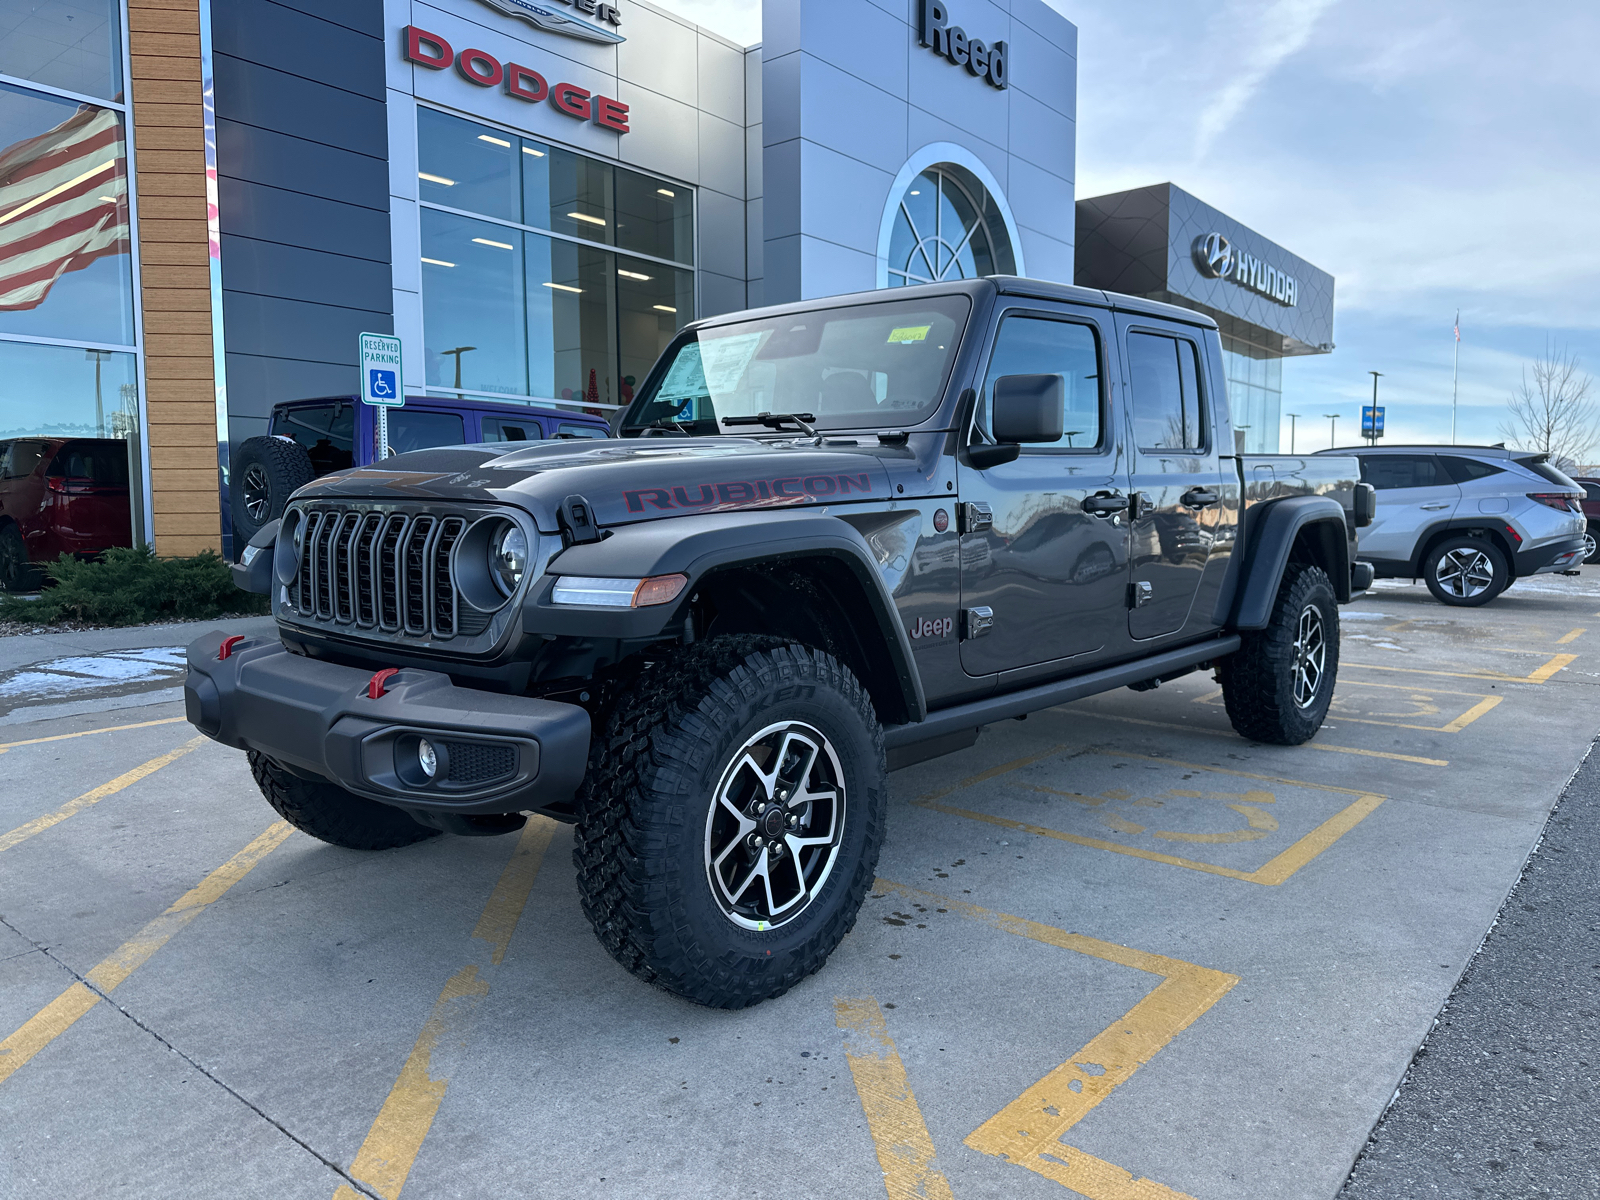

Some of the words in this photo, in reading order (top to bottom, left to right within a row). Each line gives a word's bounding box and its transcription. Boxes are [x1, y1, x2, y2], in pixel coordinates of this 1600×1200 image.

[919, 0, 1008, 90] Reed
[403, 25, 630, 134] DODGE
[1236, 250, 1298, 307] HYUNDAI
[364, 340, 399, 353] RESERVED
[364, 352, 399, 365] PARKING
[622, 473, 872, 513] RUBICON
[910, 616, 953, 639] Jeep
